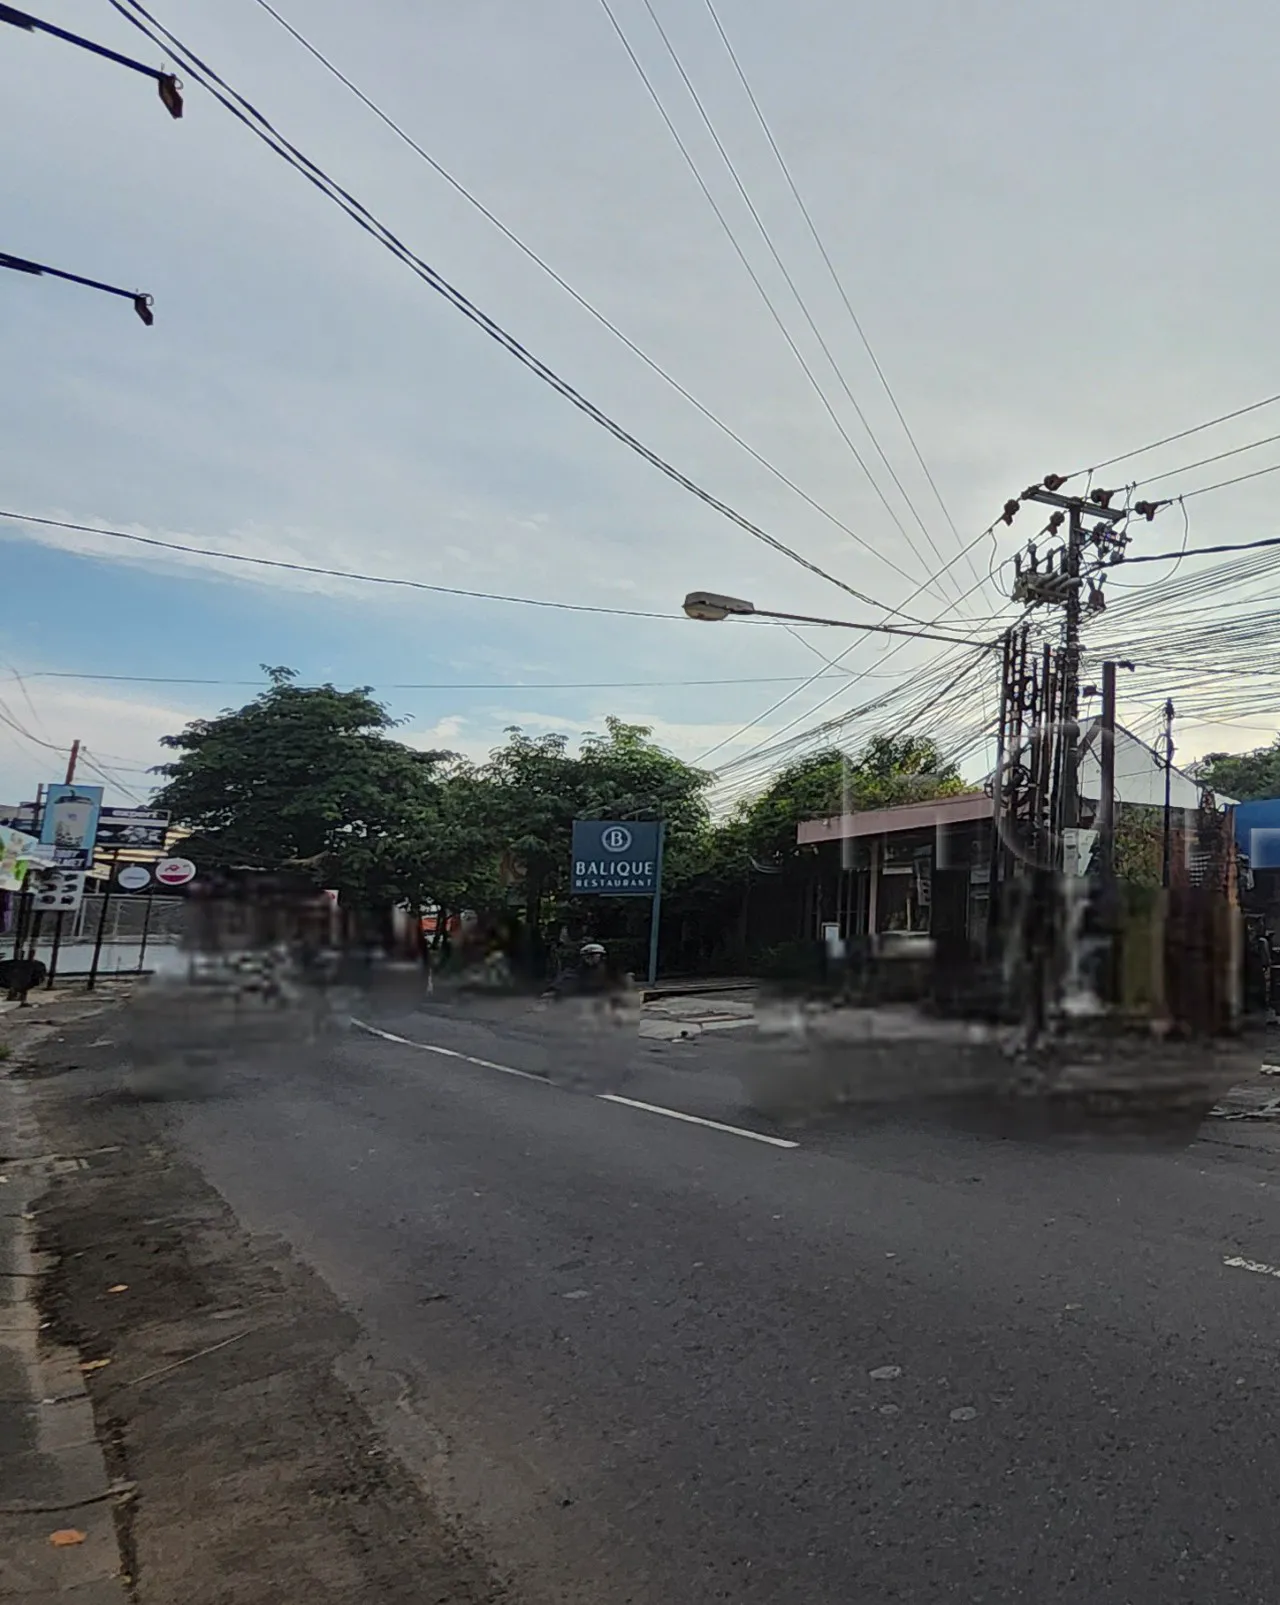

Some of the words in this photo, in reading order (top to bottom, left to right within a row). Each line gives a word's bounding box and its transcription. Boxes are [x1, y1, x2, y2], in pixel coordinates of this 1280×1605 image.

[610, 831, 622, 846] B
[575, 861, 654, 876] BALIQUE
[575, 879, 652, 888] RESTAURANT
